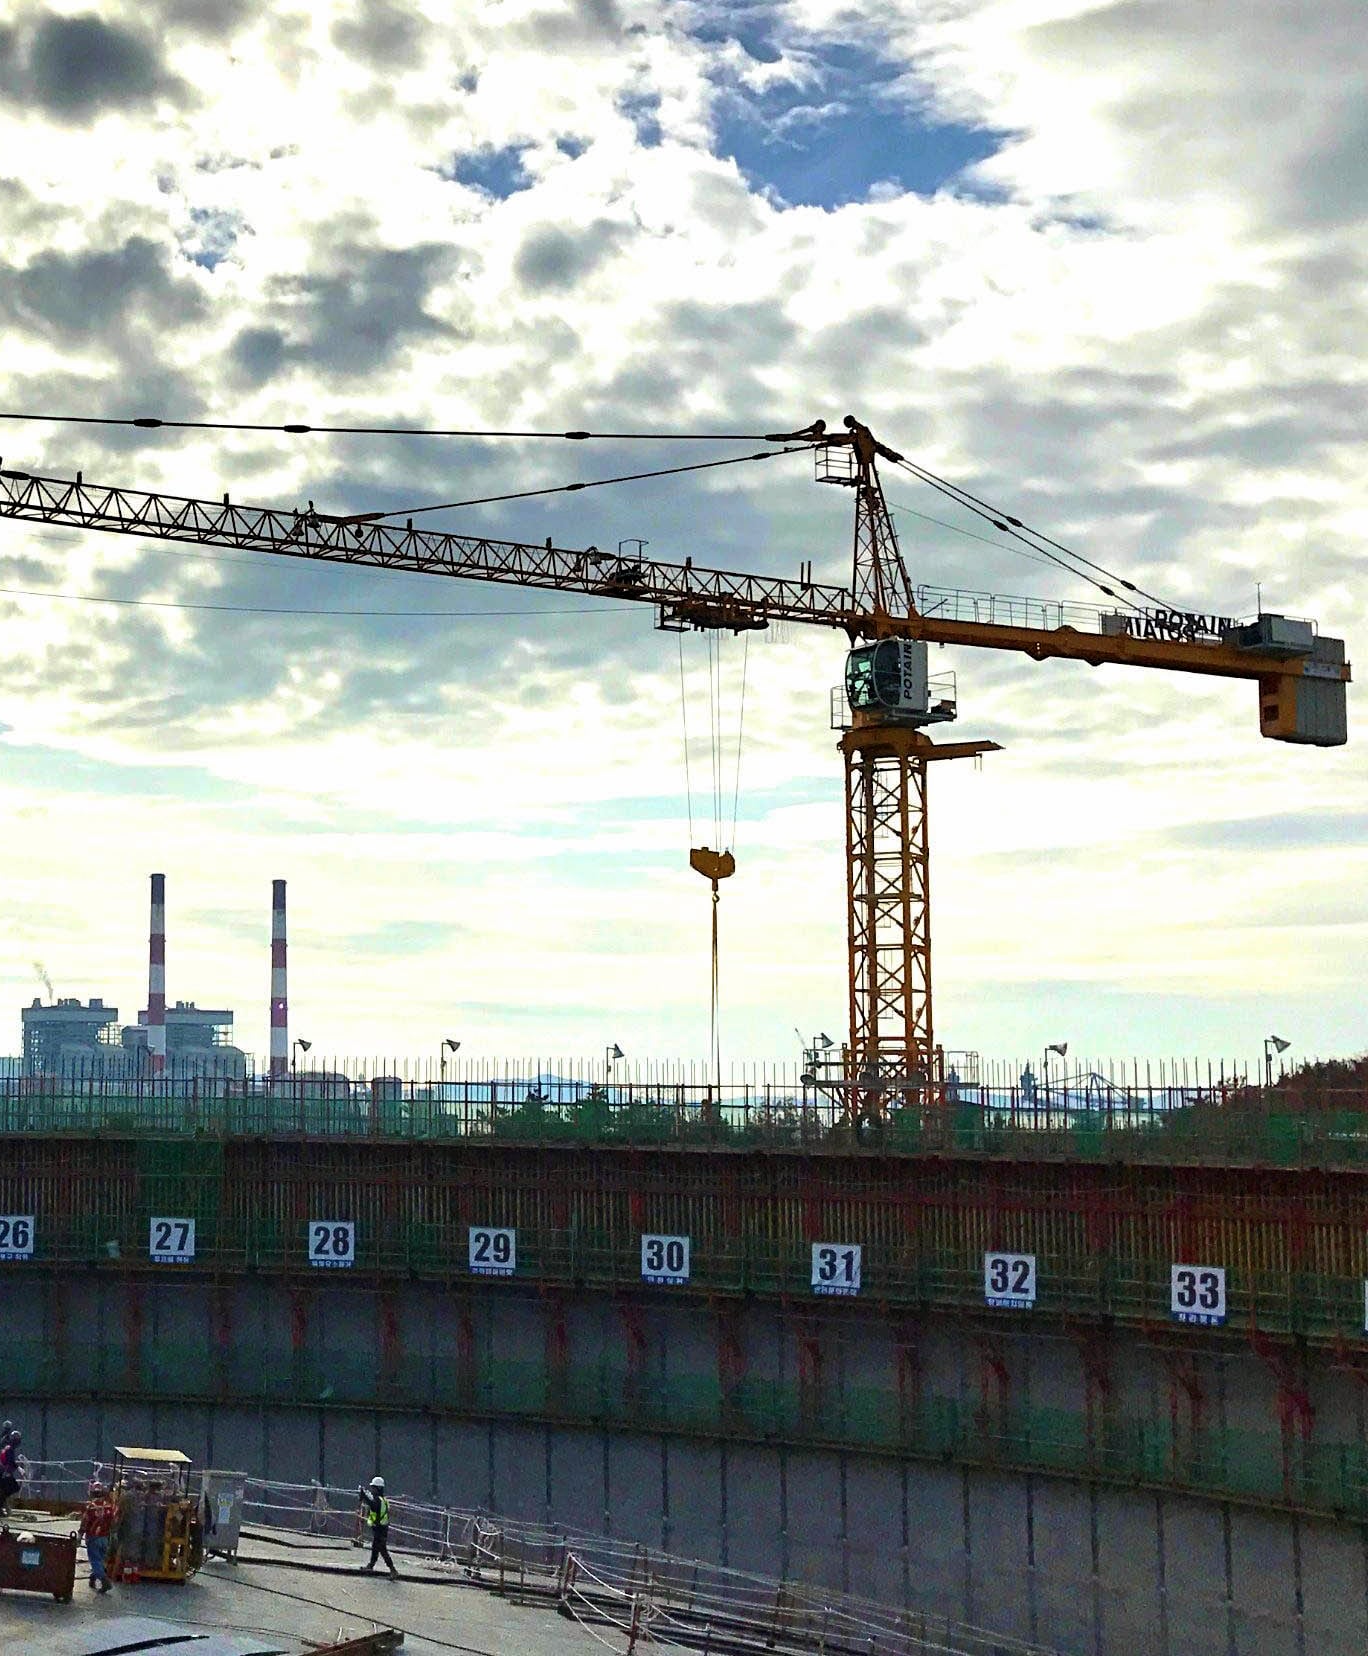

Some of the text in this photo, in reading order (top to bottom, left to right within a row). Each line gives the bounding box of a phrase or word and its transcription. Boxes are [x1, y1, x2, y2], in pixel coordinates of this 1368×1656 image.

[903, 642, 913, 700] POTAIN
[154, 1221, 190, 1252] 27
[313, 1225, 350, 1257] 28
[473, 1232, 511, 1264] 29
[646, 1239, 685, 1273] 30
[818, 1248, 855, 1283] 31
[990, 1258, 1030, 1295] 32
[1177, 1271, 1219, 1310] 33
